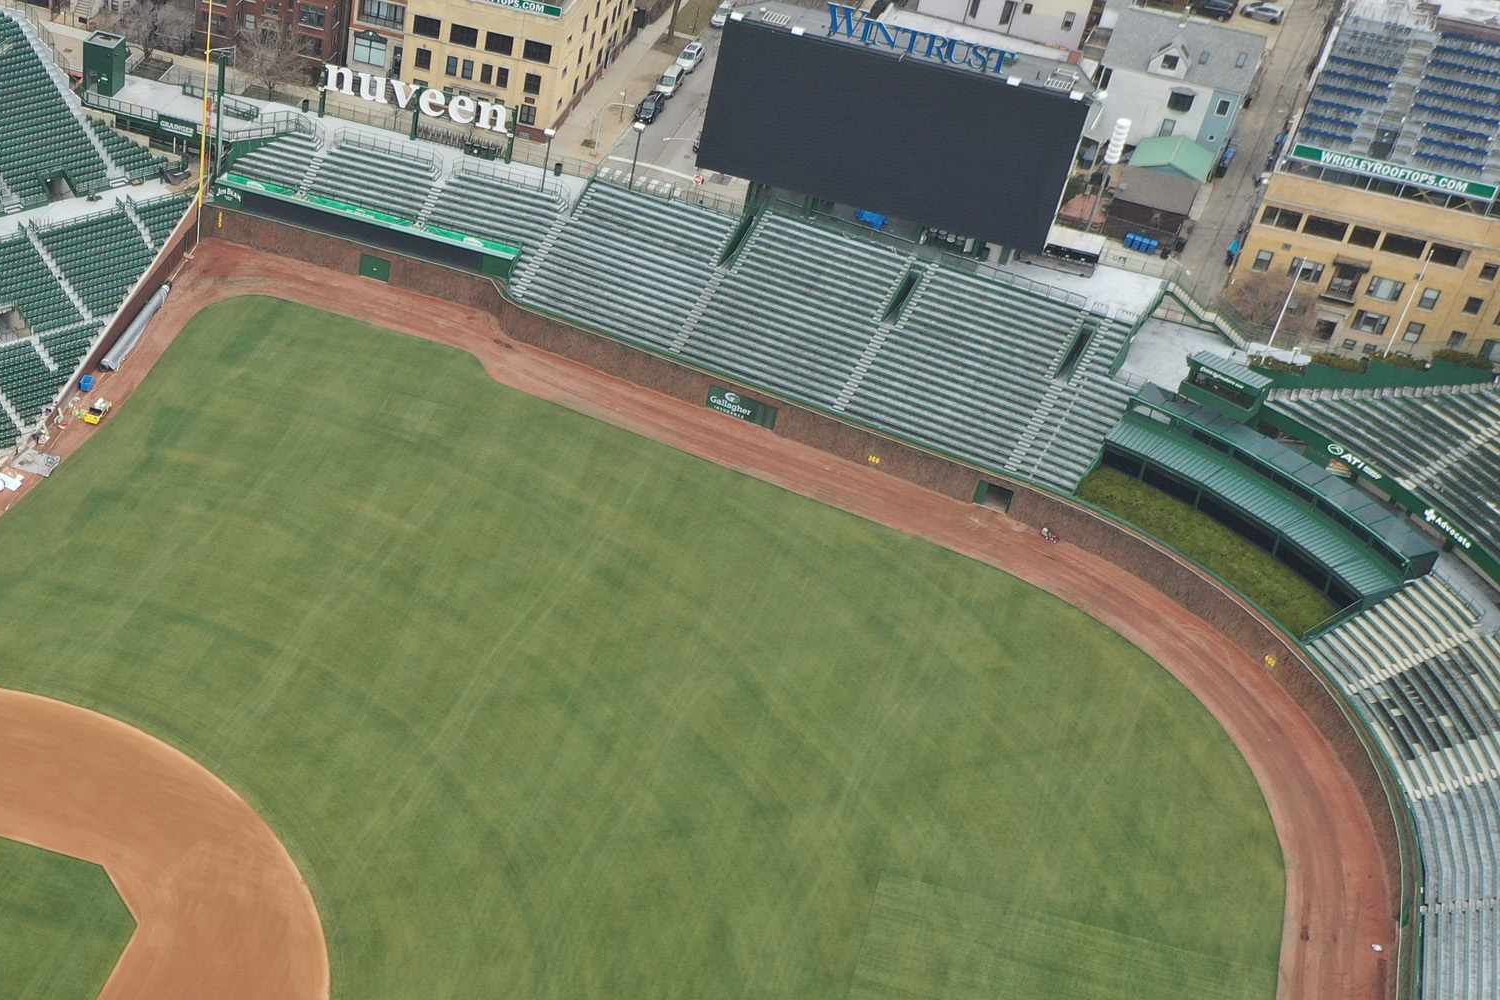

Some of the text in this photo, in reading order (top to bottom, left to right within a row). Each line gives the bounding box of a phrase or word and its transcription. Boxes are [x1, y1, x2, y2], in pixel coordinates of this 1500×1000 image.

[827, 1, 1016, 74] WINTRUST
[323, 63, 508, 134] nuveen
[159, 120, 194, 135] GRAINGER
[1320, 150, 1469, 193] WRIGLEYROOFTOPS.COM
[709, 395, 752, 416] Gallagher
[713, 405, 745, 419] INSURANCE
[1340, 453, 1365, 469] ATI
[1434, 516, 1471, 549] Advocate
